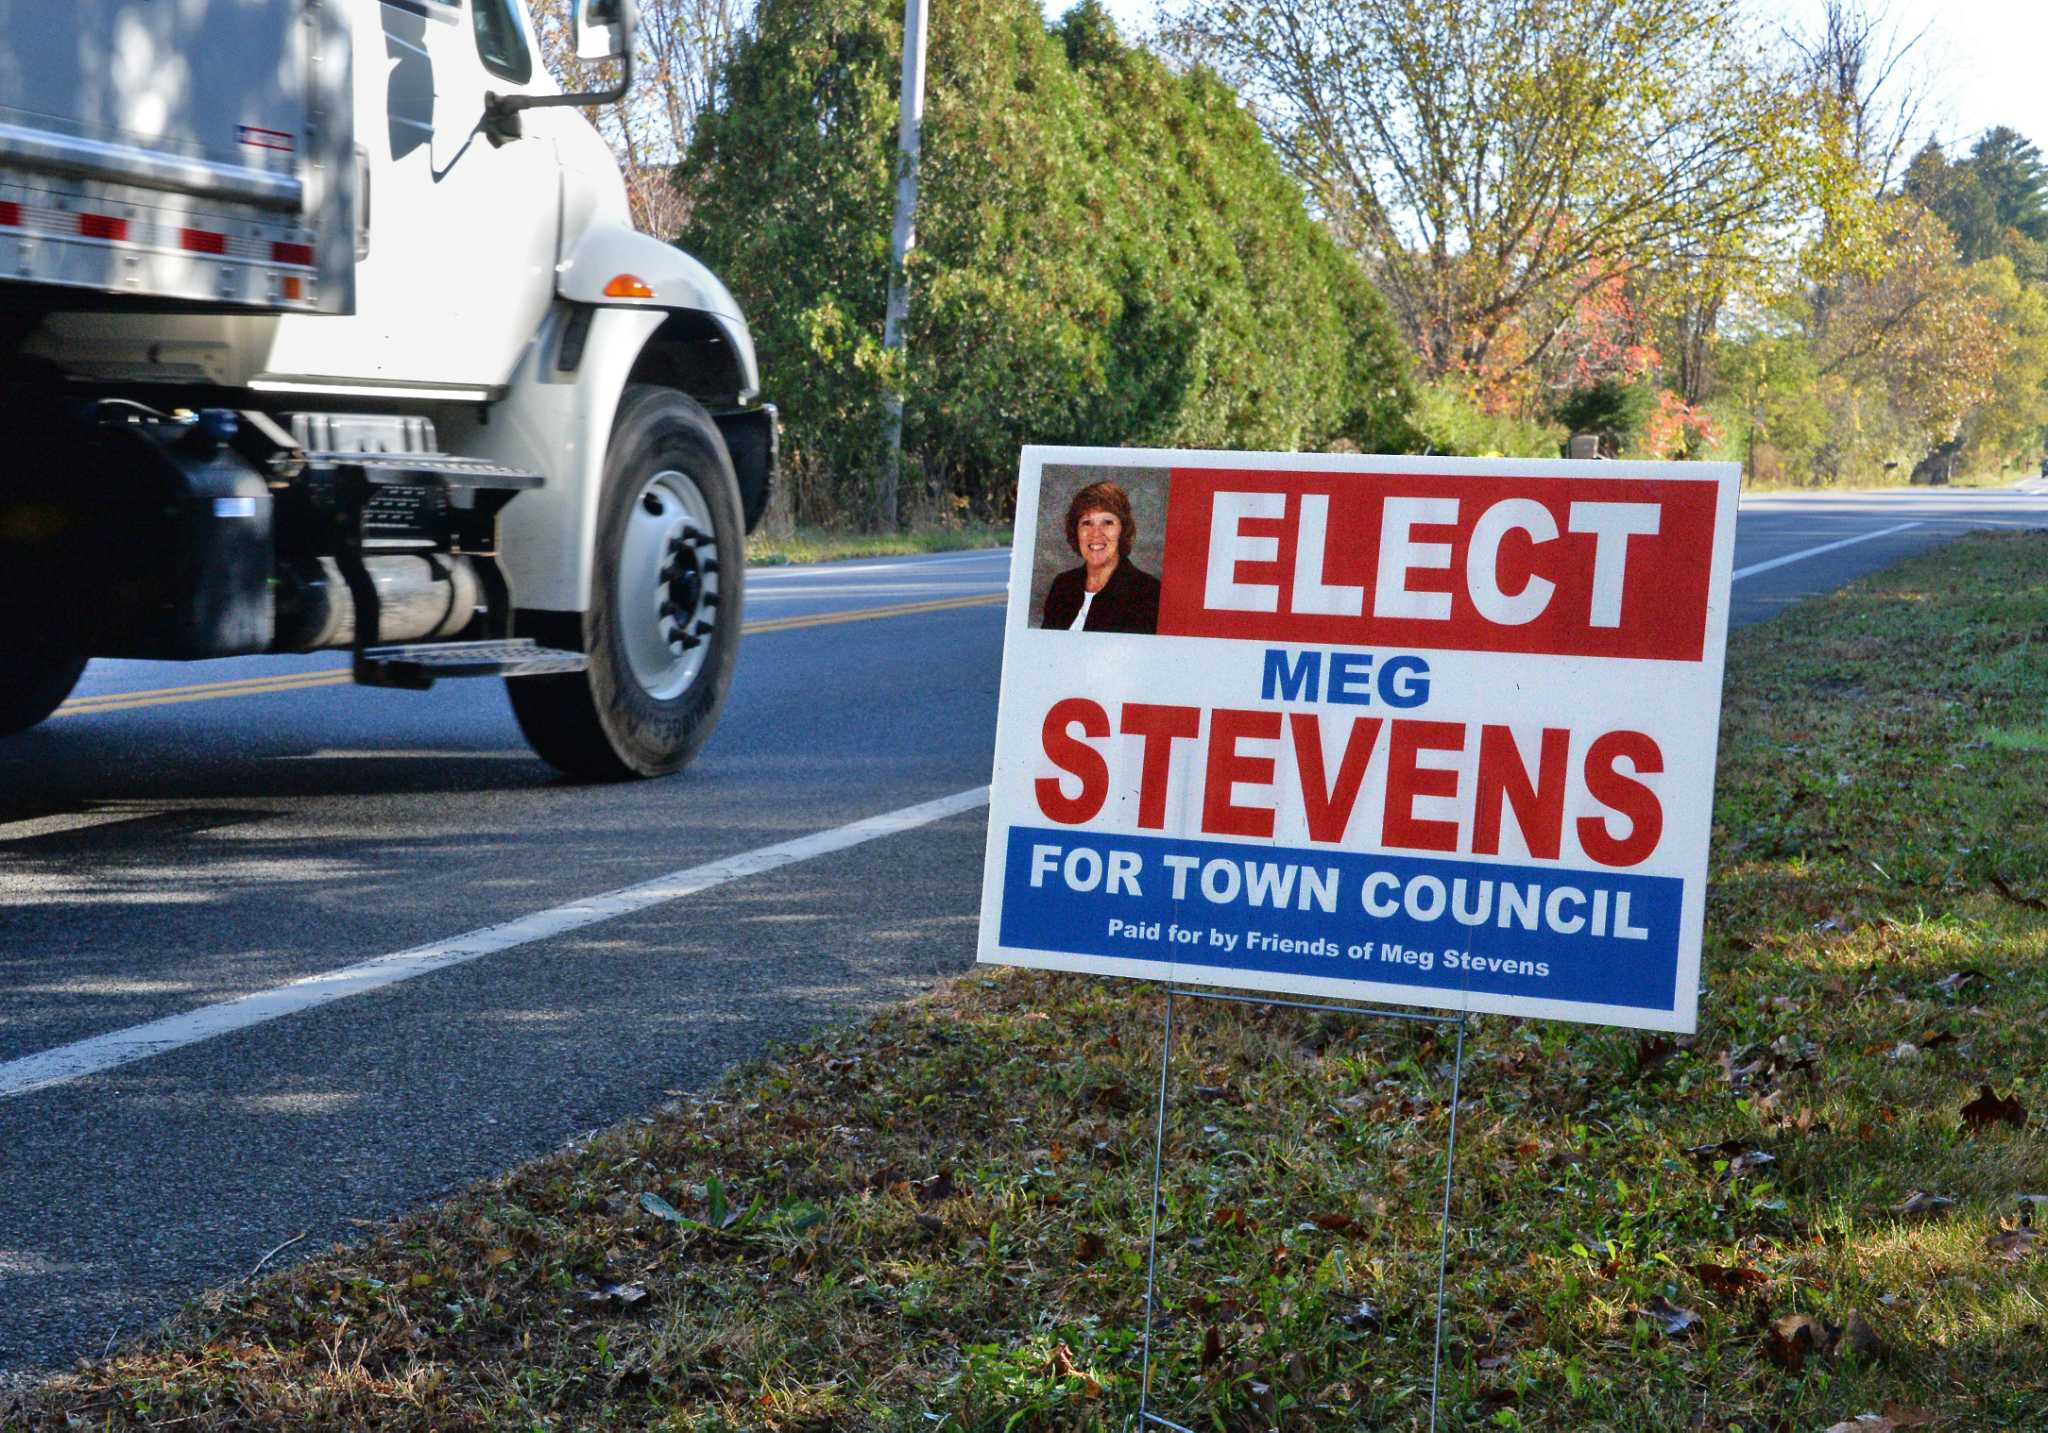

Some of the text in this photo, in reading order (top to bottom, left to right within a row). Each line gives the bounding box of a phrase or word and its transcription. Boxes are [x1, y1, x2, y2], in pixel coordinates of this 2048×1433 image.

[1203, 490, 1662, 629] ELECT
[1260, 646, 1432, 710] MEG
[1034, 697, 1665, 868] STEVENS
[1030, 844, 1649, 940] FOR TOWN COUNCIL
[1108, 918, 1550, 977] Paid for by Friends of Meg Stevens
